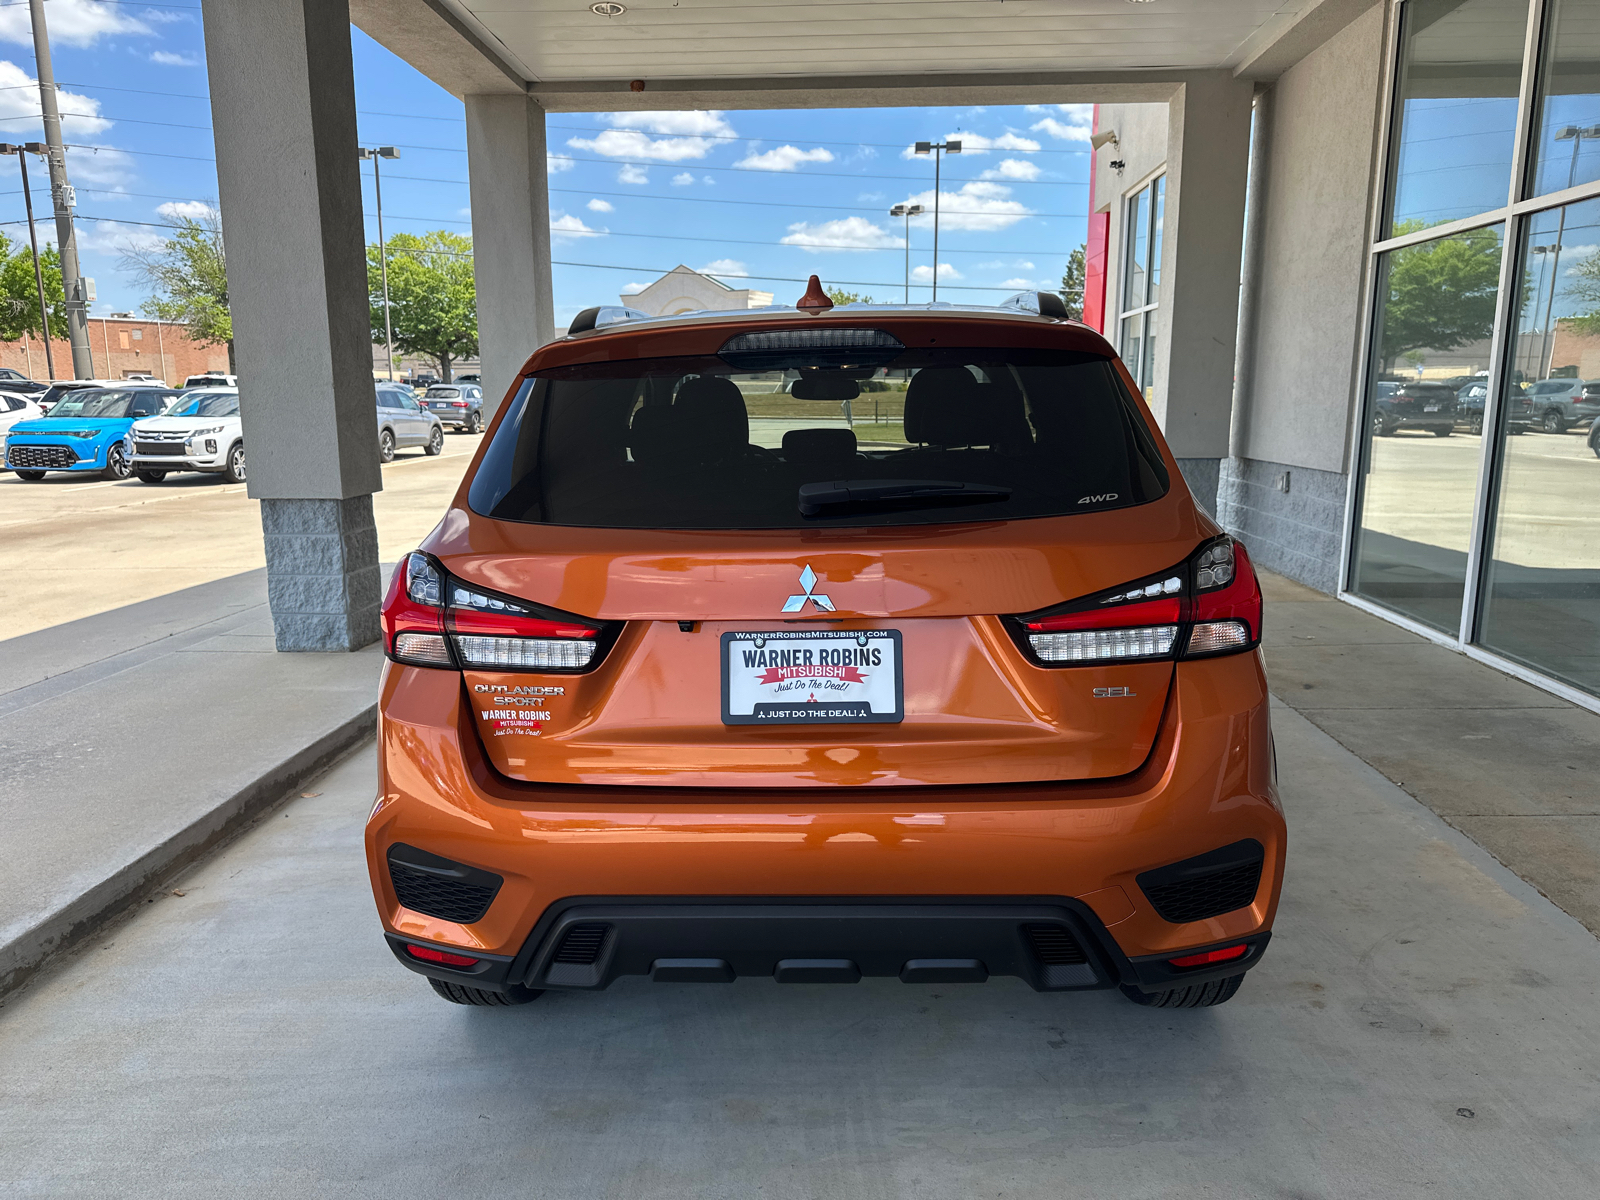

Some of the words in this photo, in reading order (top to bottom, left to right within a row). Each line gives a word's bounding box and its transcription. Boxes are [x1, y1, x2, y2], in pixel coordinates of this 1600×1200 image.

[1077, 493, 1119, 504] 4WD
[742, 649, 813, 668] WARNER
[819, 648, 882, 667] ROBINS
[778, 666, 846, 678] MITSUBISHI
[474, 684, 565, 696] OUTLANDER
[774, 682, 793, 693] Just
[794, 680, 806, 690] Do
[808, 679, 823, 689] The
[824, 681, 850, 691] Deal!
[1092, 686, 1137, 698] SEL
[493, 696, 545, 706] SPORT
[481, 709, 517, 720] WARNER
[518, 710, 551, 720] ROBINS
[767, 710, 791, 718] JUST
[829, 709, 857, 717] DEAL!
